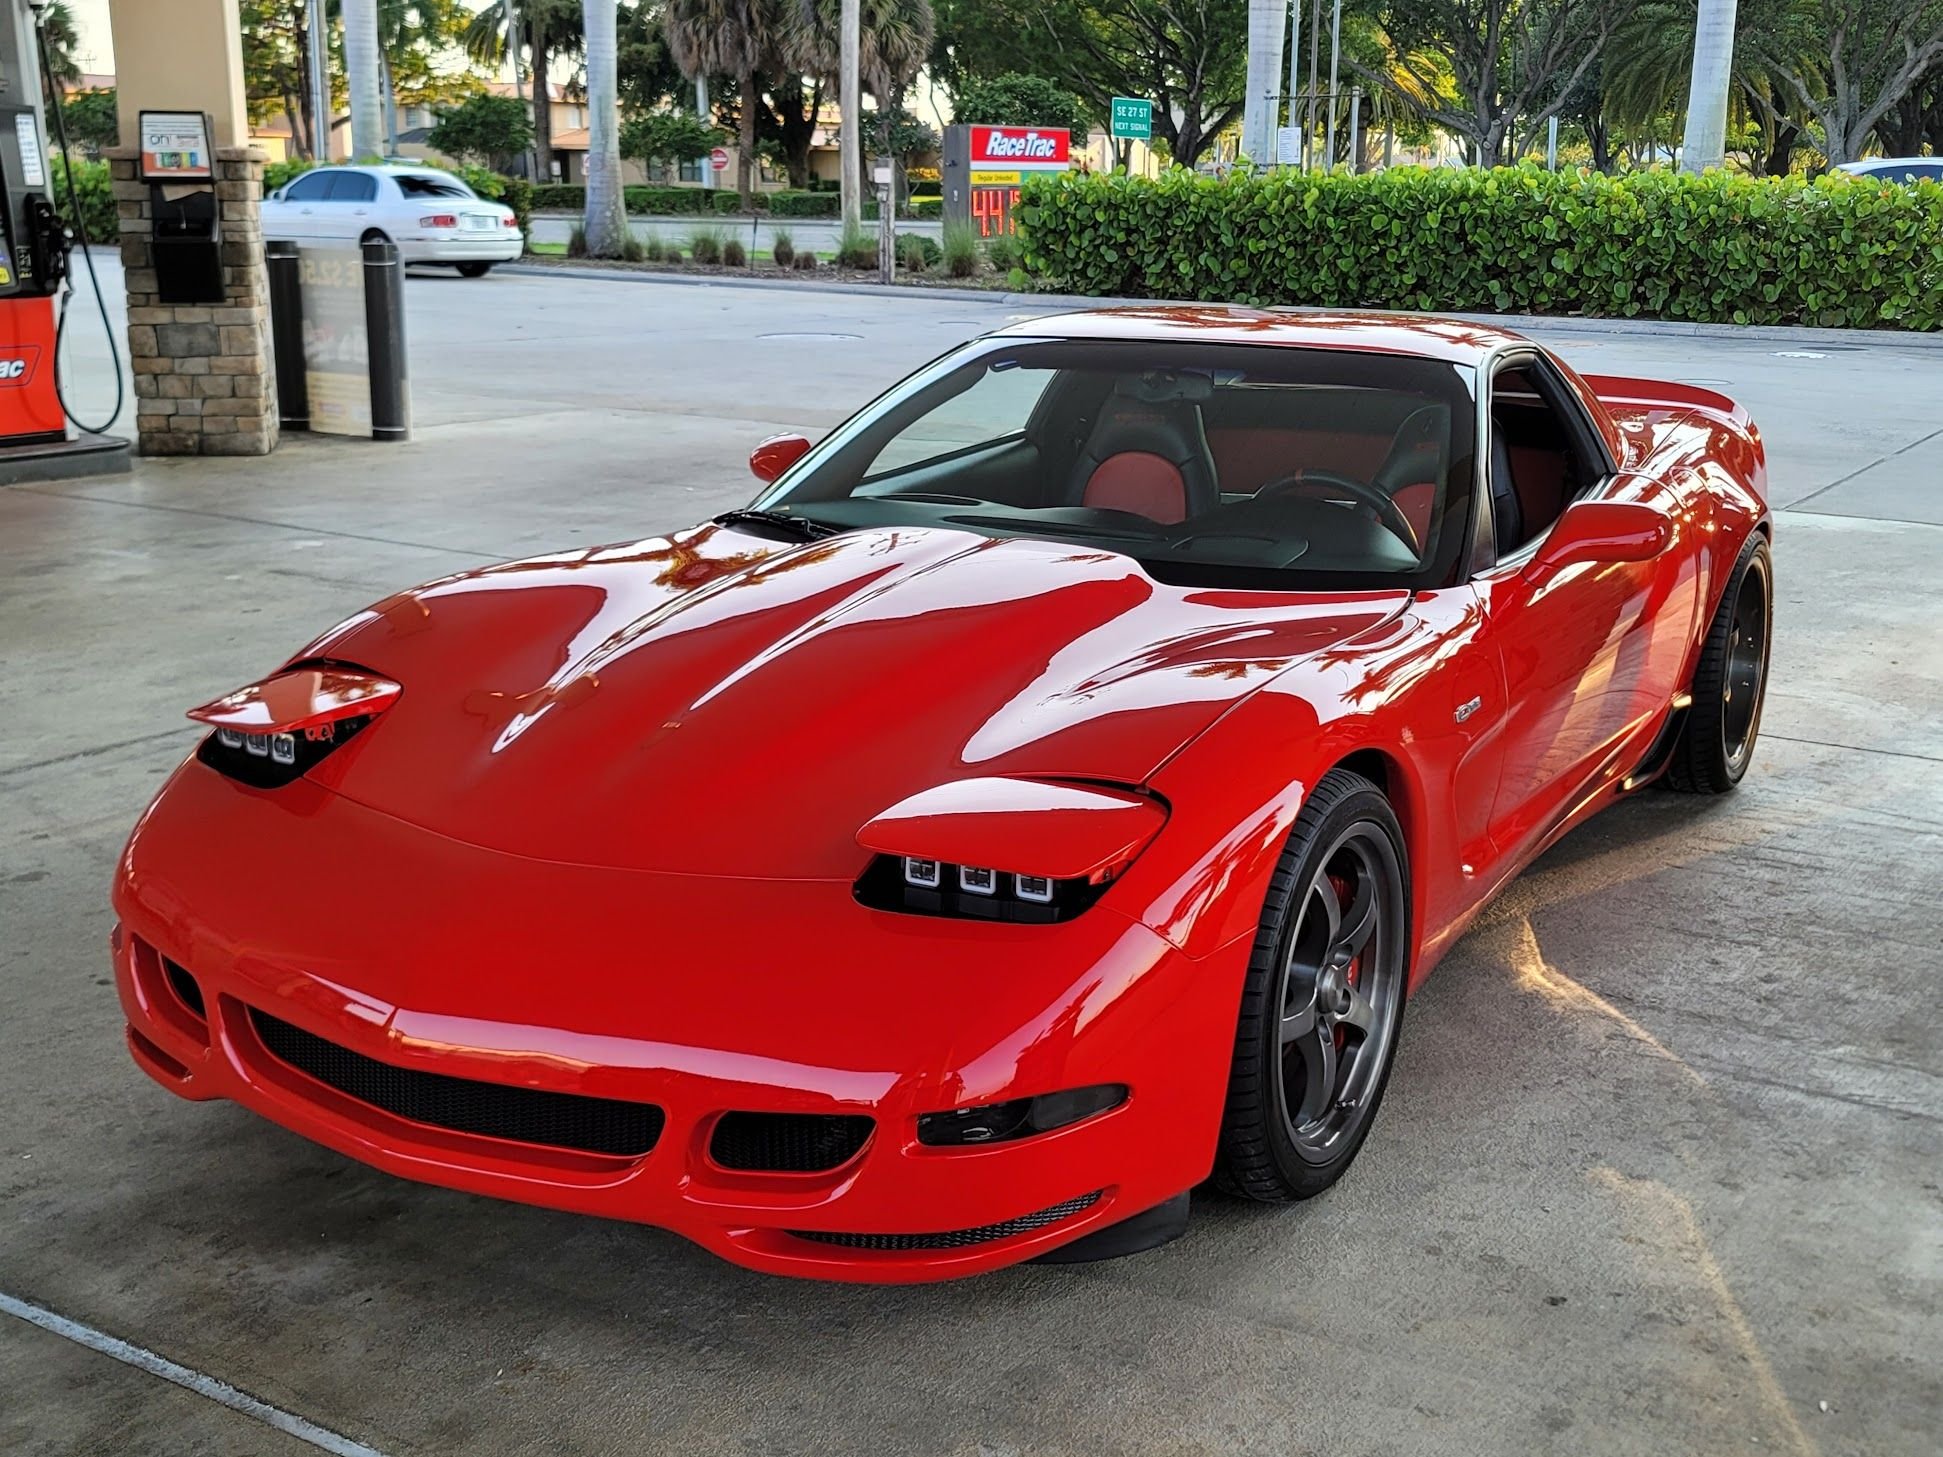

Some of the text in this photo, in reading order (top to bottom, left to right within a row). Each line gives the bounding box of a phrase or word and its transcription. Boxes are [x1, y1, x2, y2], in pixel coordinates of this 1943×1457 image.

[1117, 106, 1147, 118] SE 27 ST
[986, 131, 1055, 156] RaceTrac
